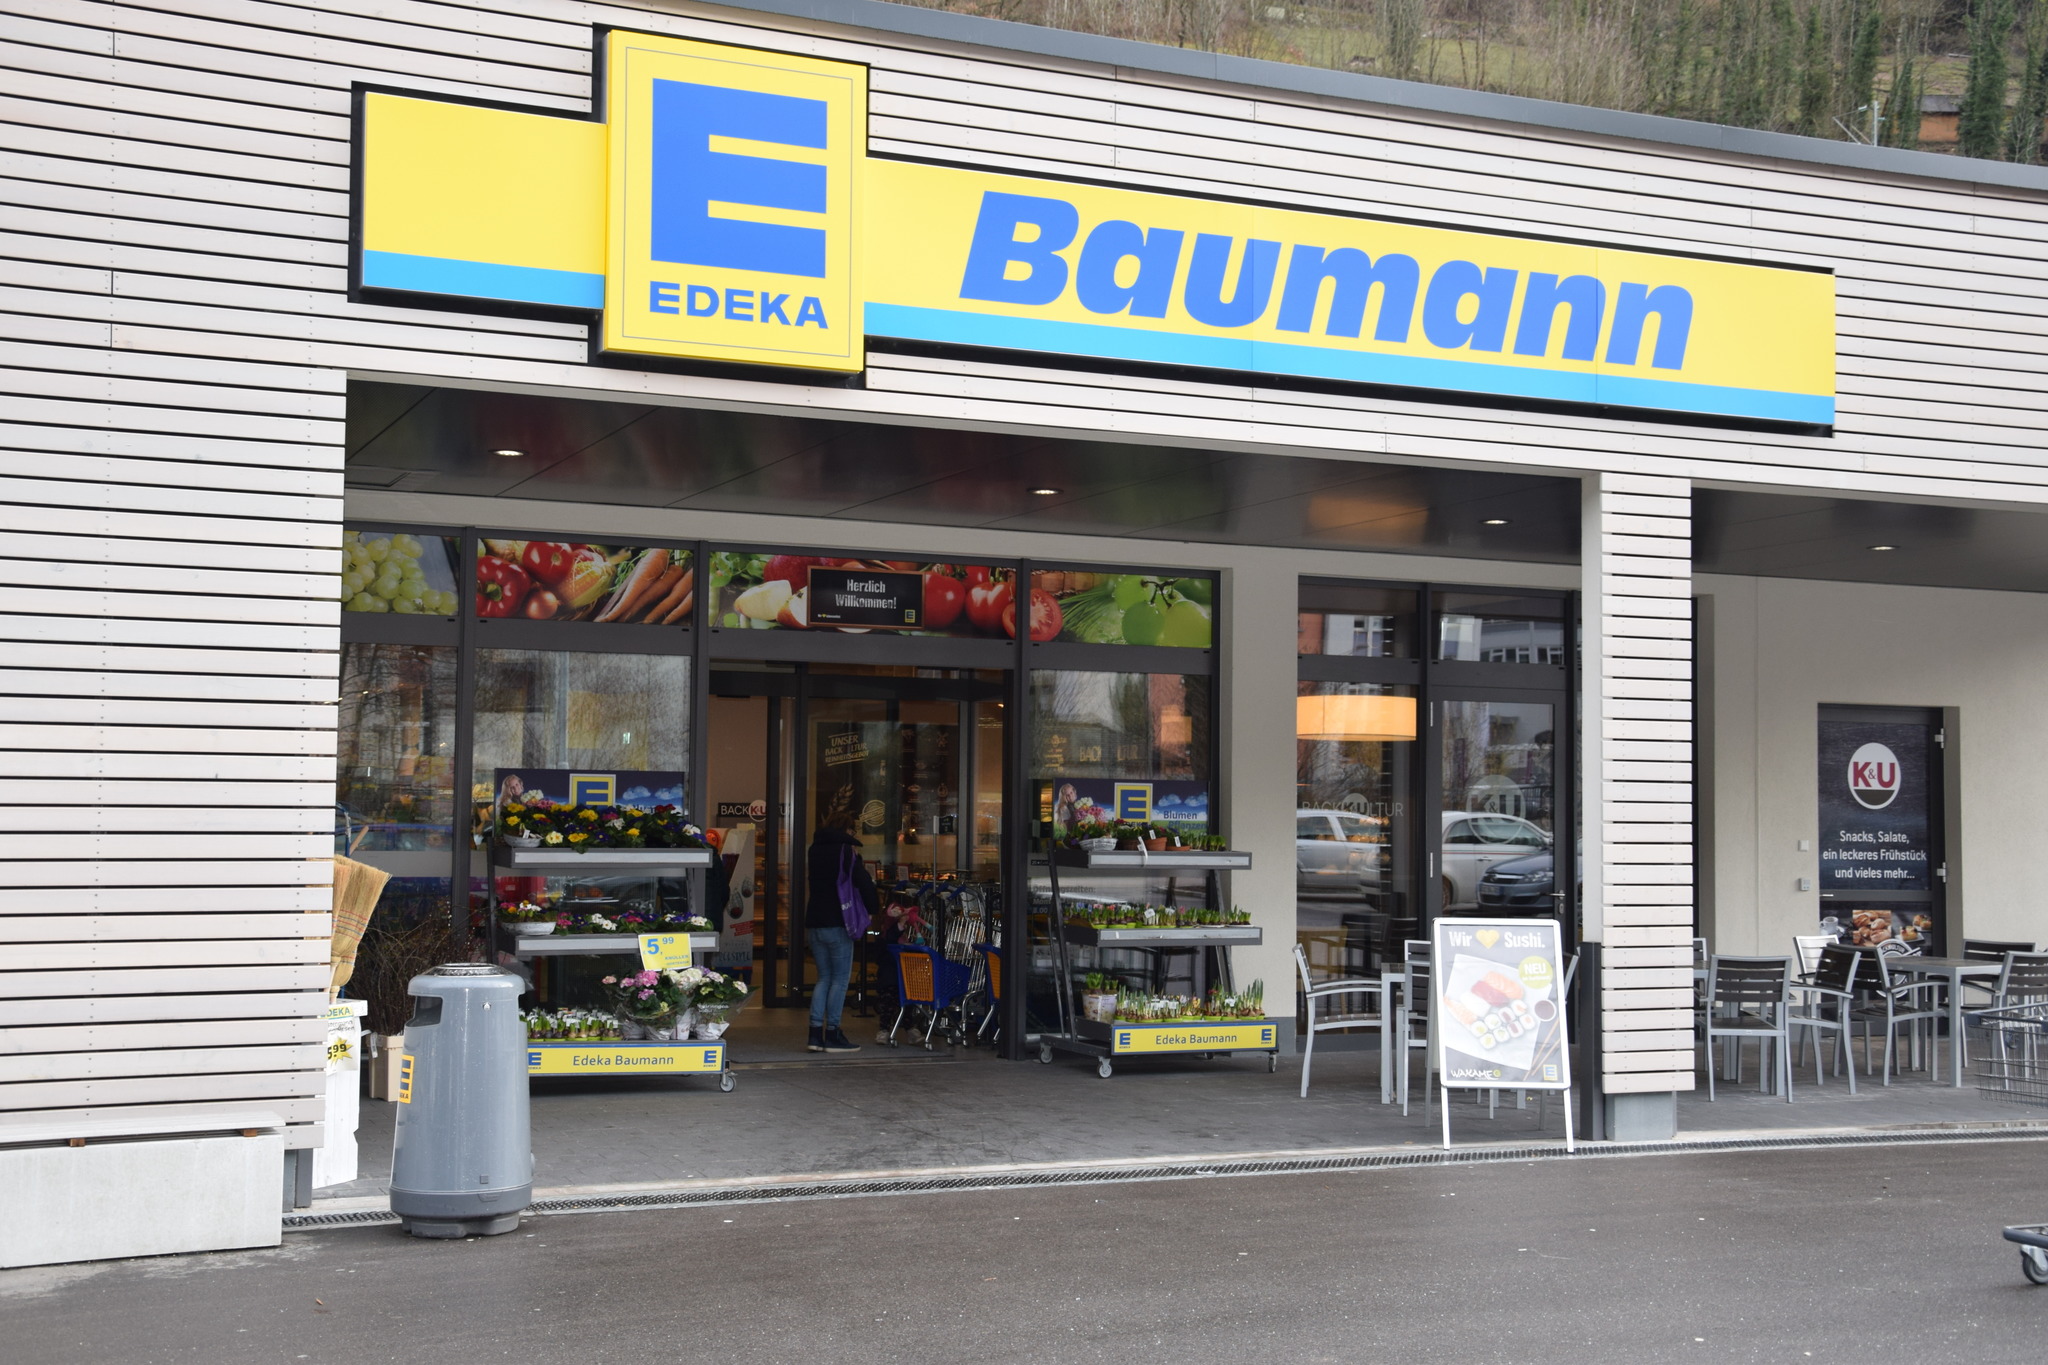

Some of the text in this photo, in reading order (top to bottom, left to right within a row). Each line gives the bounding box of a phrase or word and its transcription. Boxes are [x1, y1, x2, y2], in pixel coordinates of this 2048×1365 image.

[650, 77, 828, 278] E
[958, 190, 1694, 371] Baumann
[649, 280, 829, 330] EDEKA
[846, 578, 886, 593] Herzlich
[835, 593, 897, 609] Willkommen!
[831, 735, 859, 746] UNSER
[1853, 761, 1896, 788] K&U
[1121, 790, 1147, 819] E
[1163, 810, 1197, 820] Blumen
[1839, 830, 1910, 844] Snacks, Salate,
[1822, 848, 1927, 861] ein leckeres Frühstück
[1835, 867, 1915, 879] und vieles mehr...
[1449, 931, 1545, 948] Wir Sushi.
[1524, 963, 1546, 975] NEU
[320, 1007, 351, 1018] DEKA
[1119, 1032, 1131, 1045] E
[1155, 1034, 1237, 1045] Edeka Baumann
[1262, 1029, 1272, 1041] E
[572, 1054, 674, 1066] Edeka Baumann
[704, 1050, 717, 1064] E
